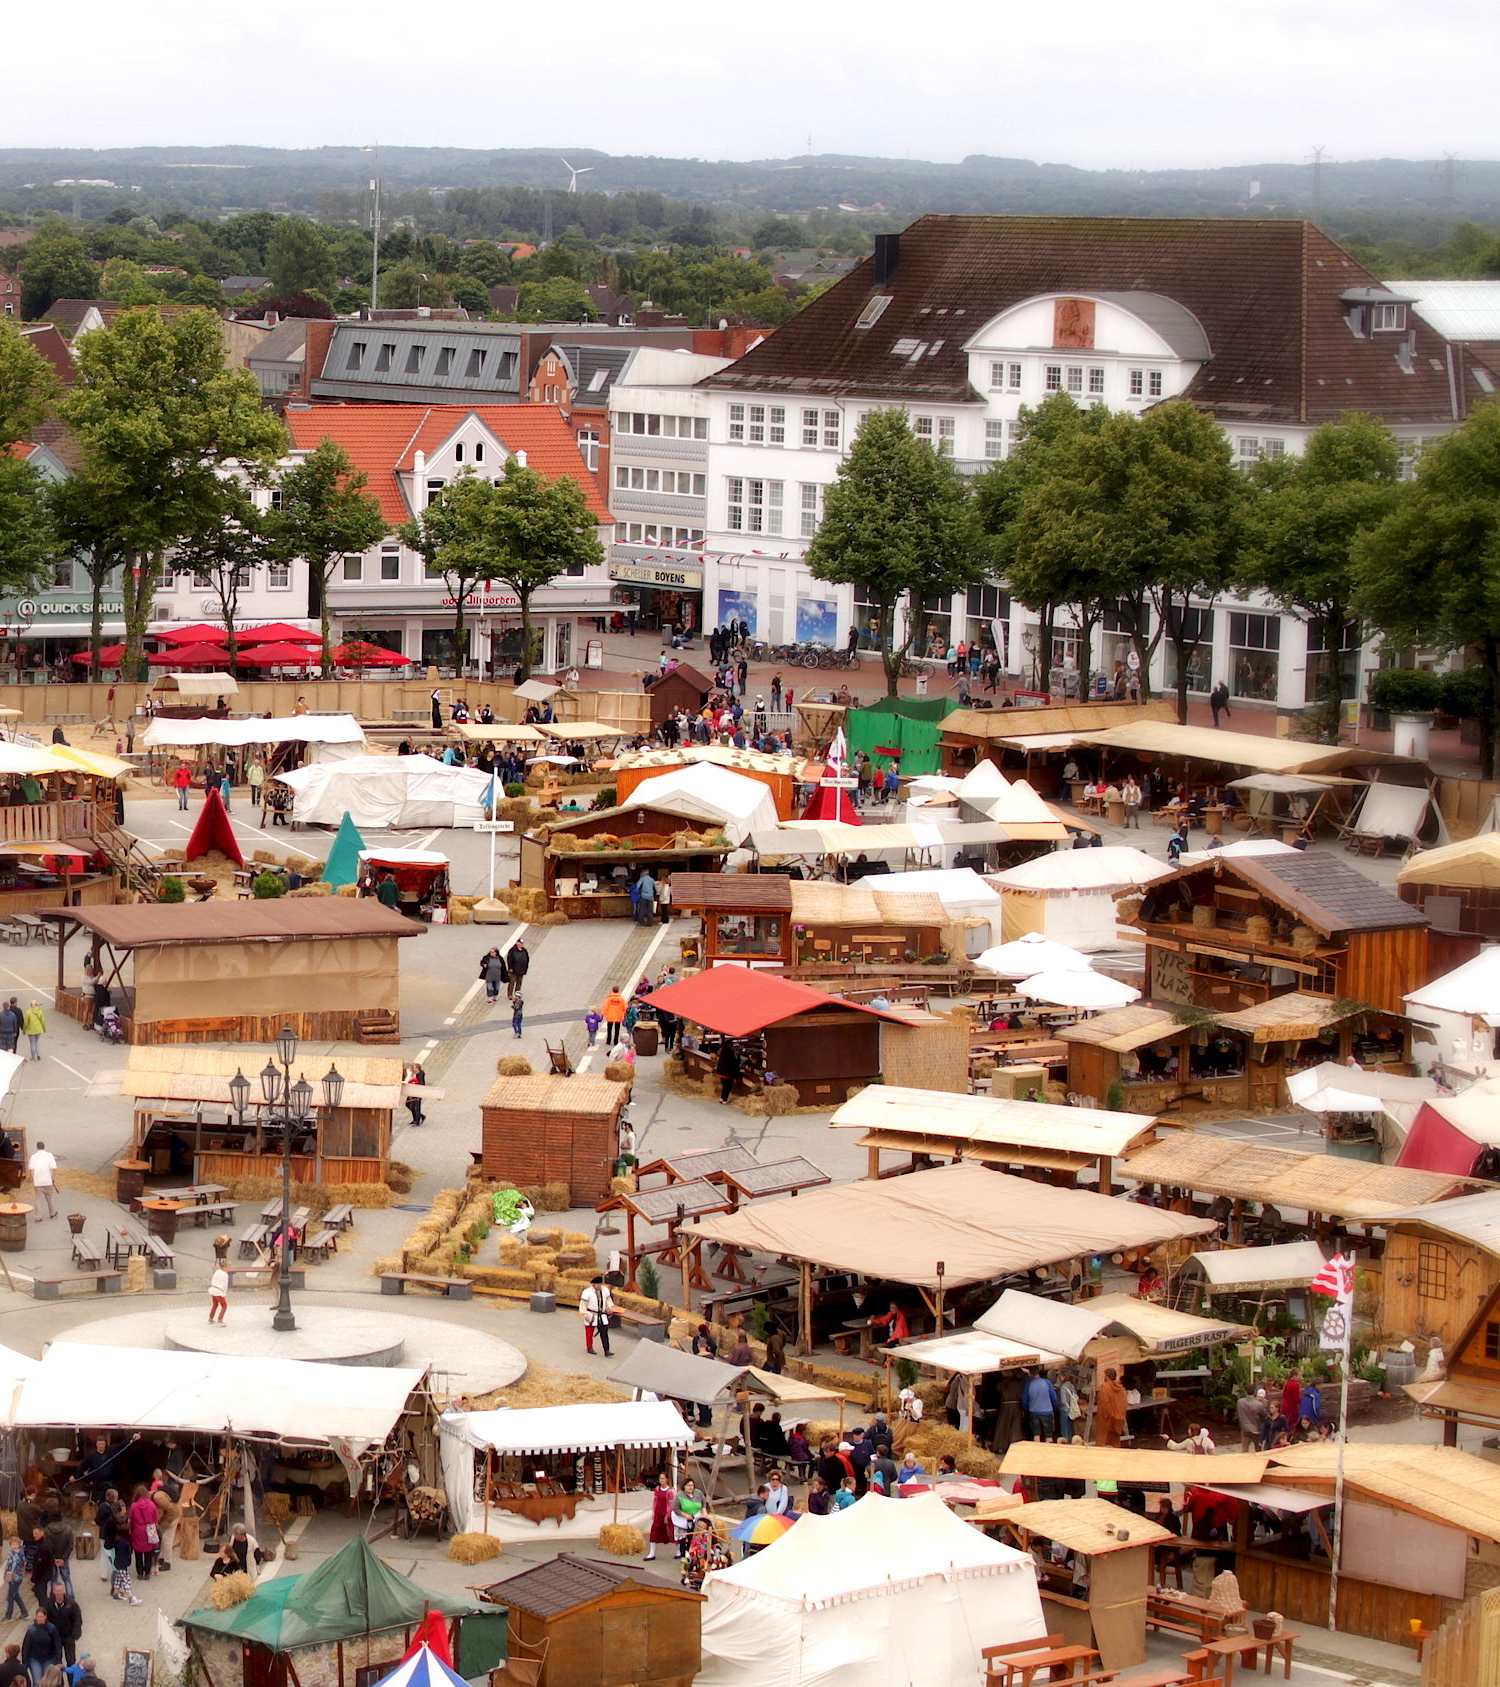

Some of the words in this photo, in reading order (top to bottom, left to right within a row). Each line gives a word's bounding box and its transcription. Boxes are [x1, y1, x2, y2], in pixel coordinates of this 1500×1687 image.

[654, 571, 686, 584] BOYENS
[40, 602, 79, 615] QUICK
[1164, 1334, 1202, 1350] PILGERS
[1203, 1331, 1229, 1344] RAST
